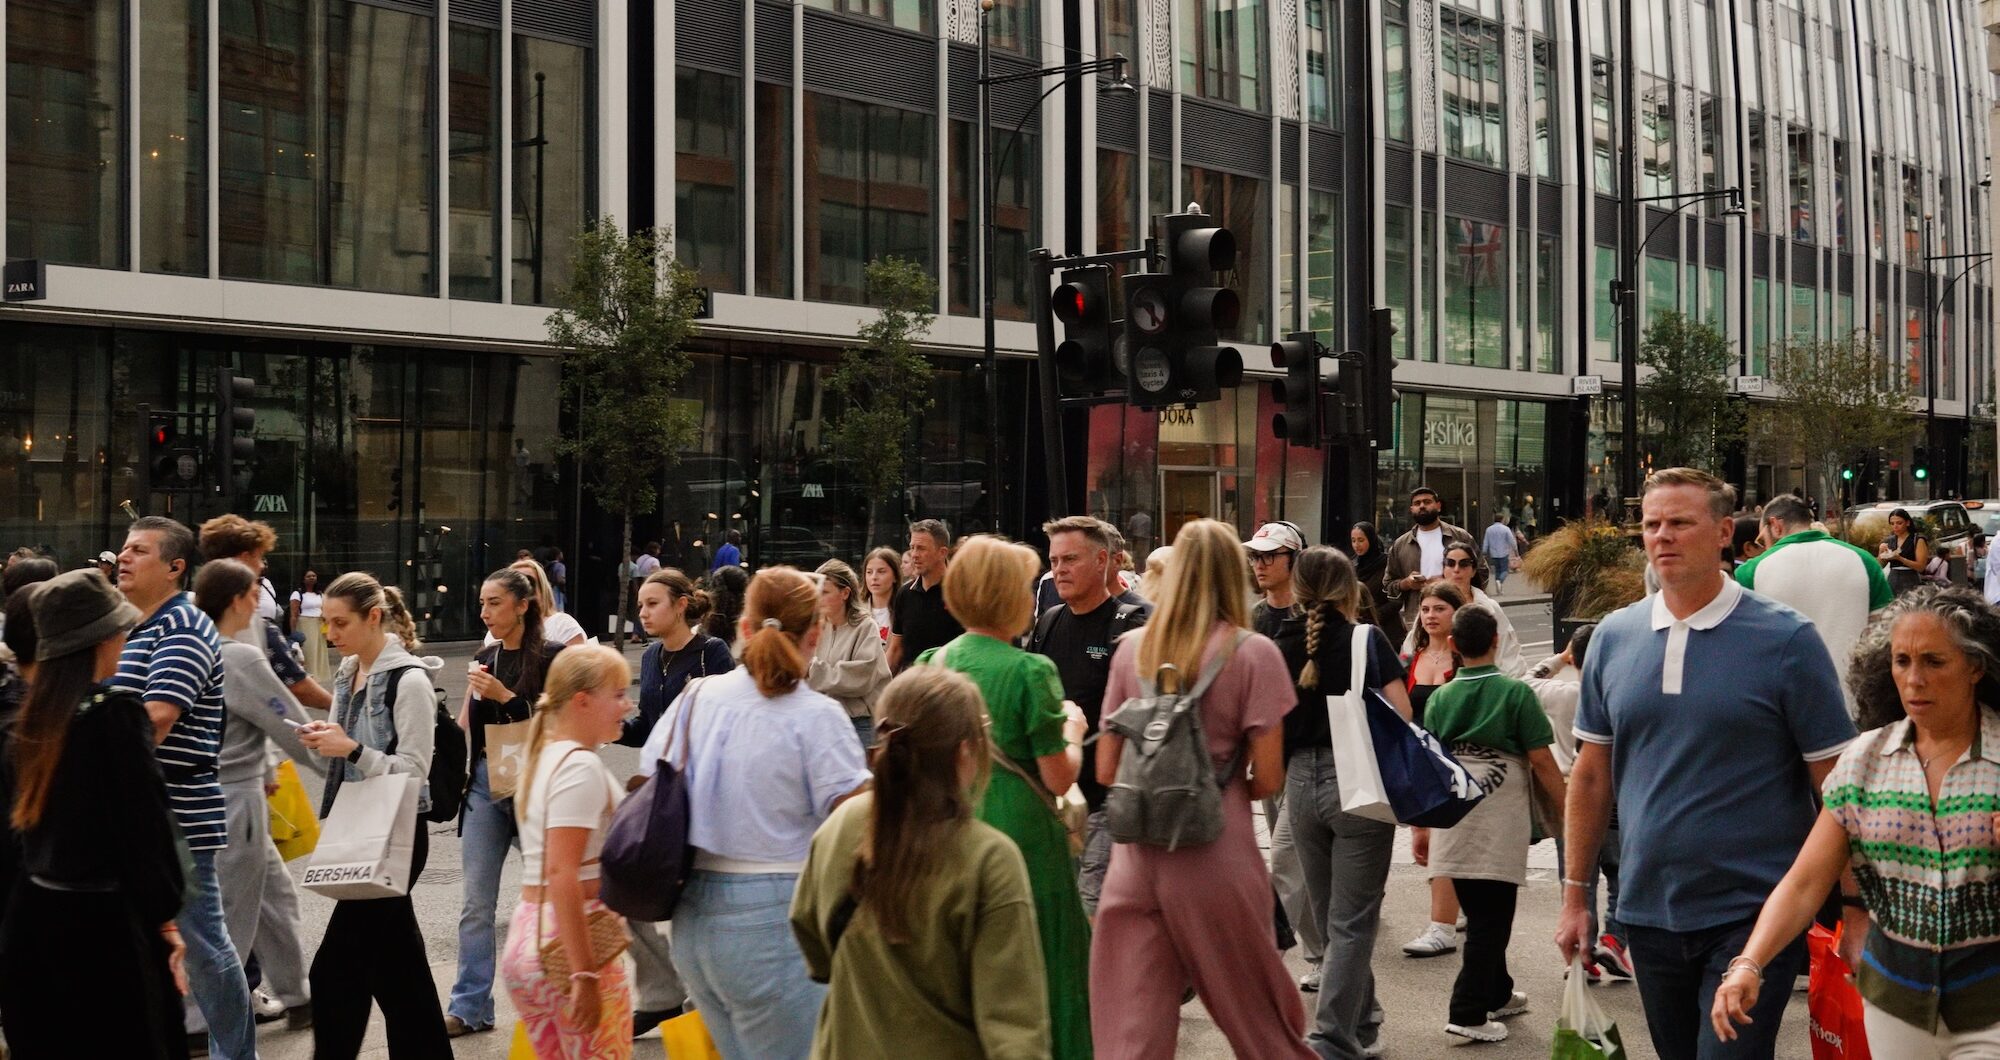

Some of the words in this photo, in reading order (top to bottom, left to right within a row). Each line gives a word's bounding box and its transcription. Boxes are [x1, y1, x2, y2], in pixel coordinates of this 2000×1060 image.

[8, 283, 35, 292] ZARA
[254, 494, 289, 512] ZARA
[304, 866, 372, 883] BERSHKA
